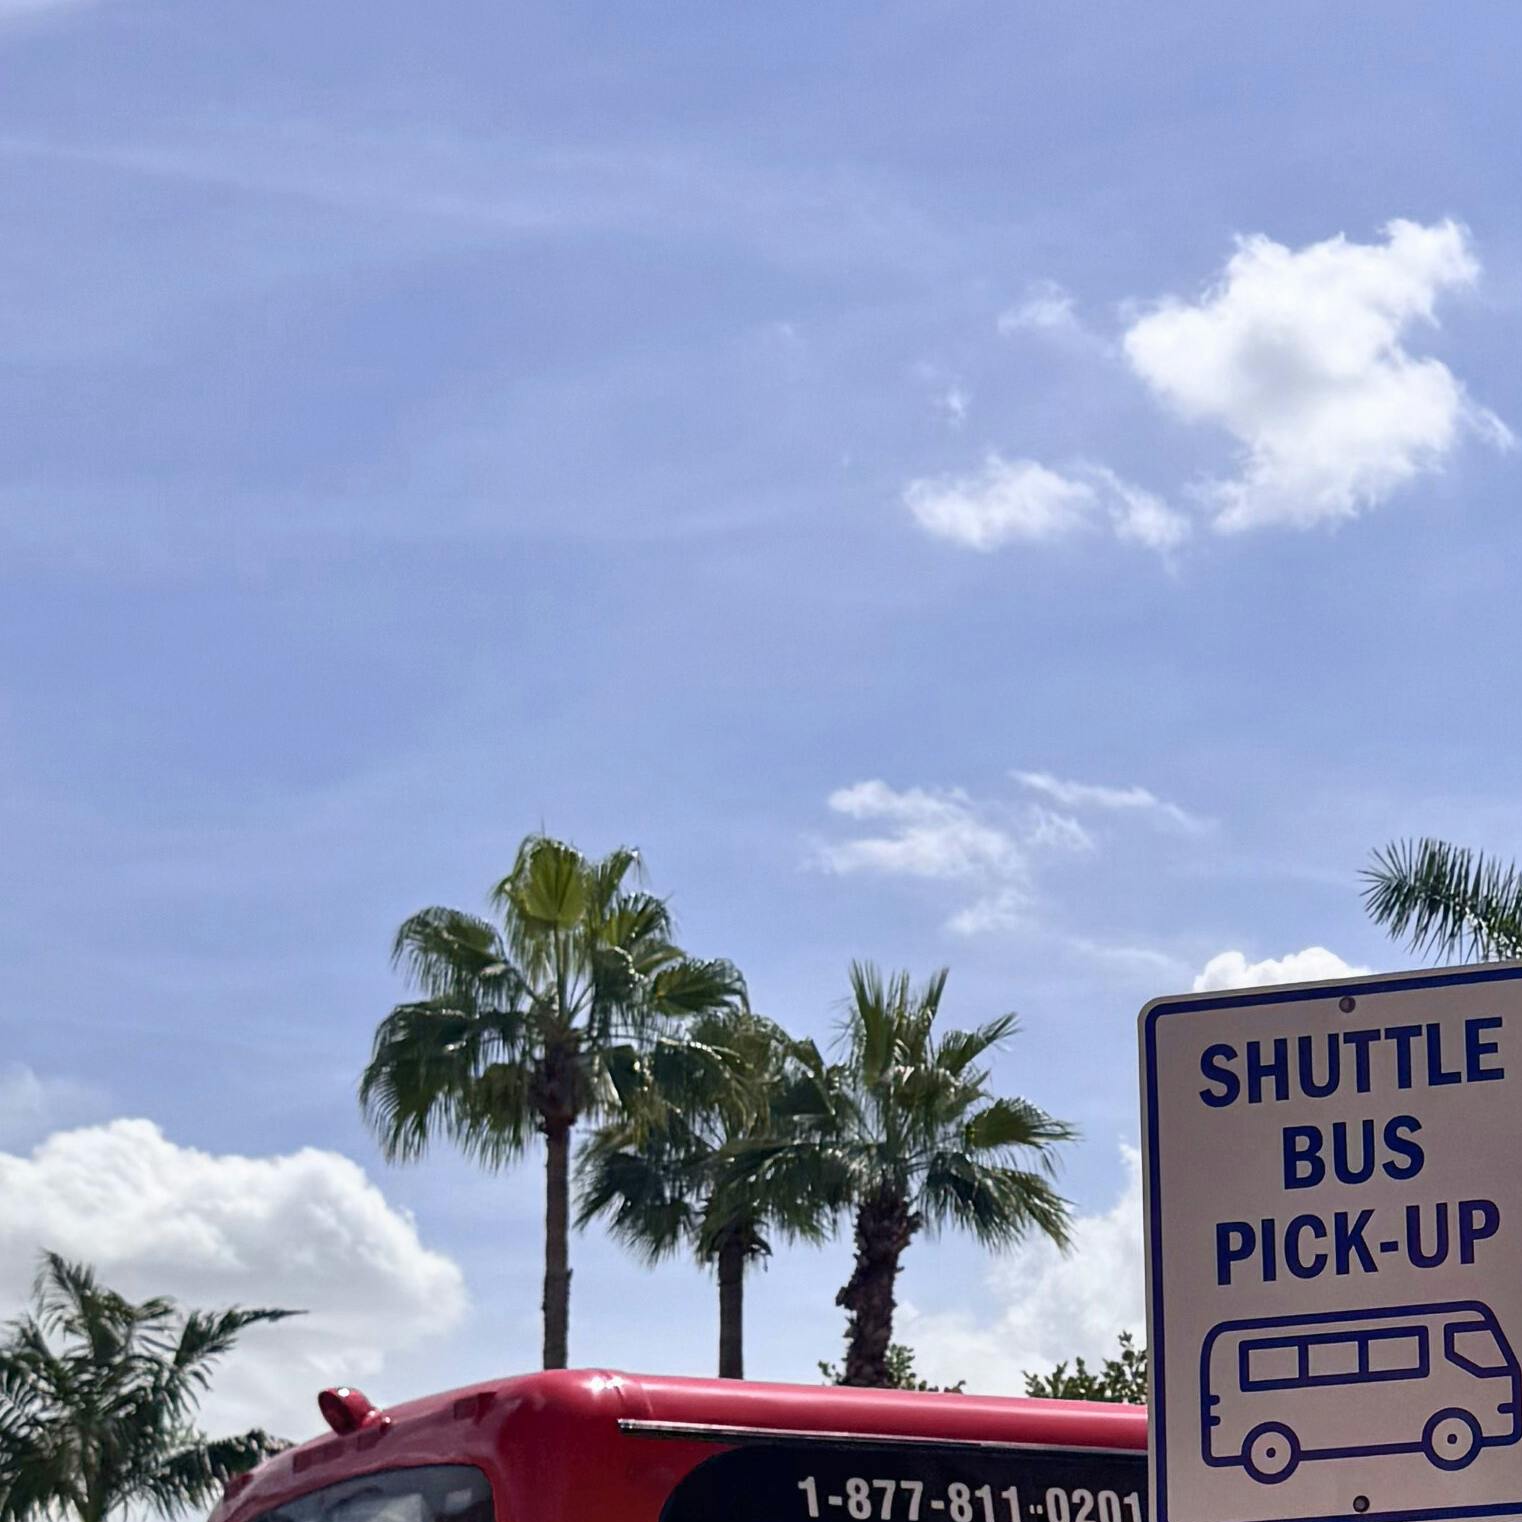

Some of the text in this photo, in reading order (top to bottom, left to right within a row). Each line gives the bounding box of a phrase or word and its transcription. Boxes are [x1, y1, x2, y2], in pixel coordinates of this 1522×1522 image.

[1199, 1016, 1505, 1108] SHUTTLE
[1282, 1114, 1425, 1190] BUS
[1215, 1199, 1501, 1286] PICK-UP
